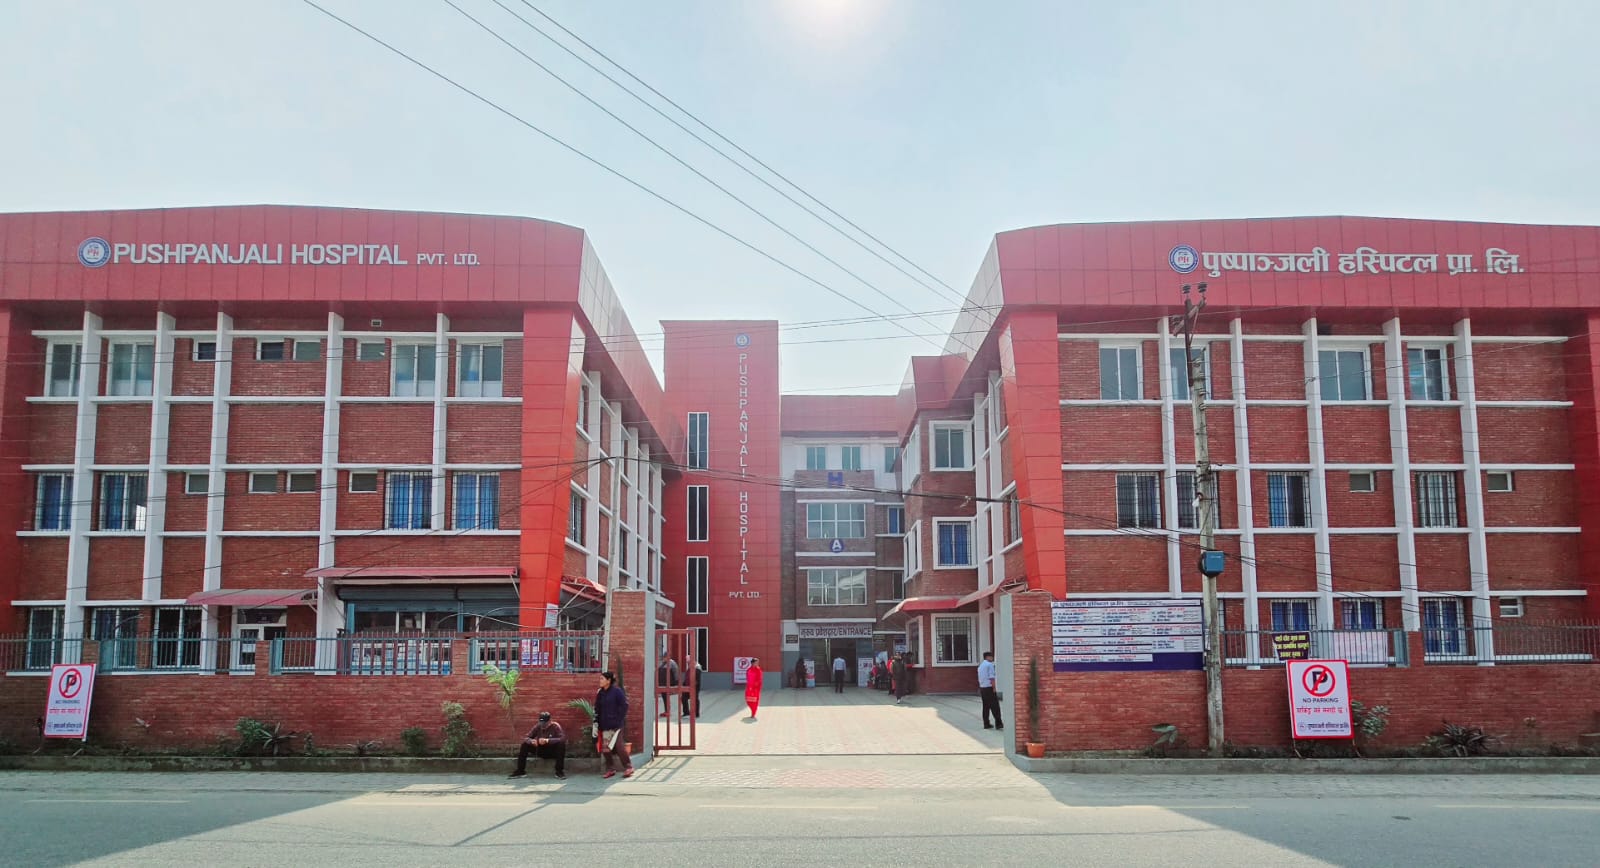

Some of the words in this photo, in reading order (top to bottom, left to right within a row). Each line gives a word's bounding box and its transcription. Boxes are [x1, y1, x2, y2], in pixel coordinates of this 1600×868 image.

[113, 243, 282, 264] PUSHPANJALI
[291, 243, 408, 265] HOSPITAL
[416, 253, 448, 265] PVT.
[453, 253, 480, 265] LTD.
[1338, 246, 1438, 274] हस्पिटल
[1446, 254, 1478, 275] प्रा.
[1486, 248, 1524, 274] लि.
[739, 353, 748, 478] PUSHPANJALI
[827, 471, 843, 488] H
[739, 491, 749, 585] HOSPITAL
[831, 539, 842, 552] A
[728, 591, 743, 599] PVT.
[746, 591, 761, 599] LTD.
